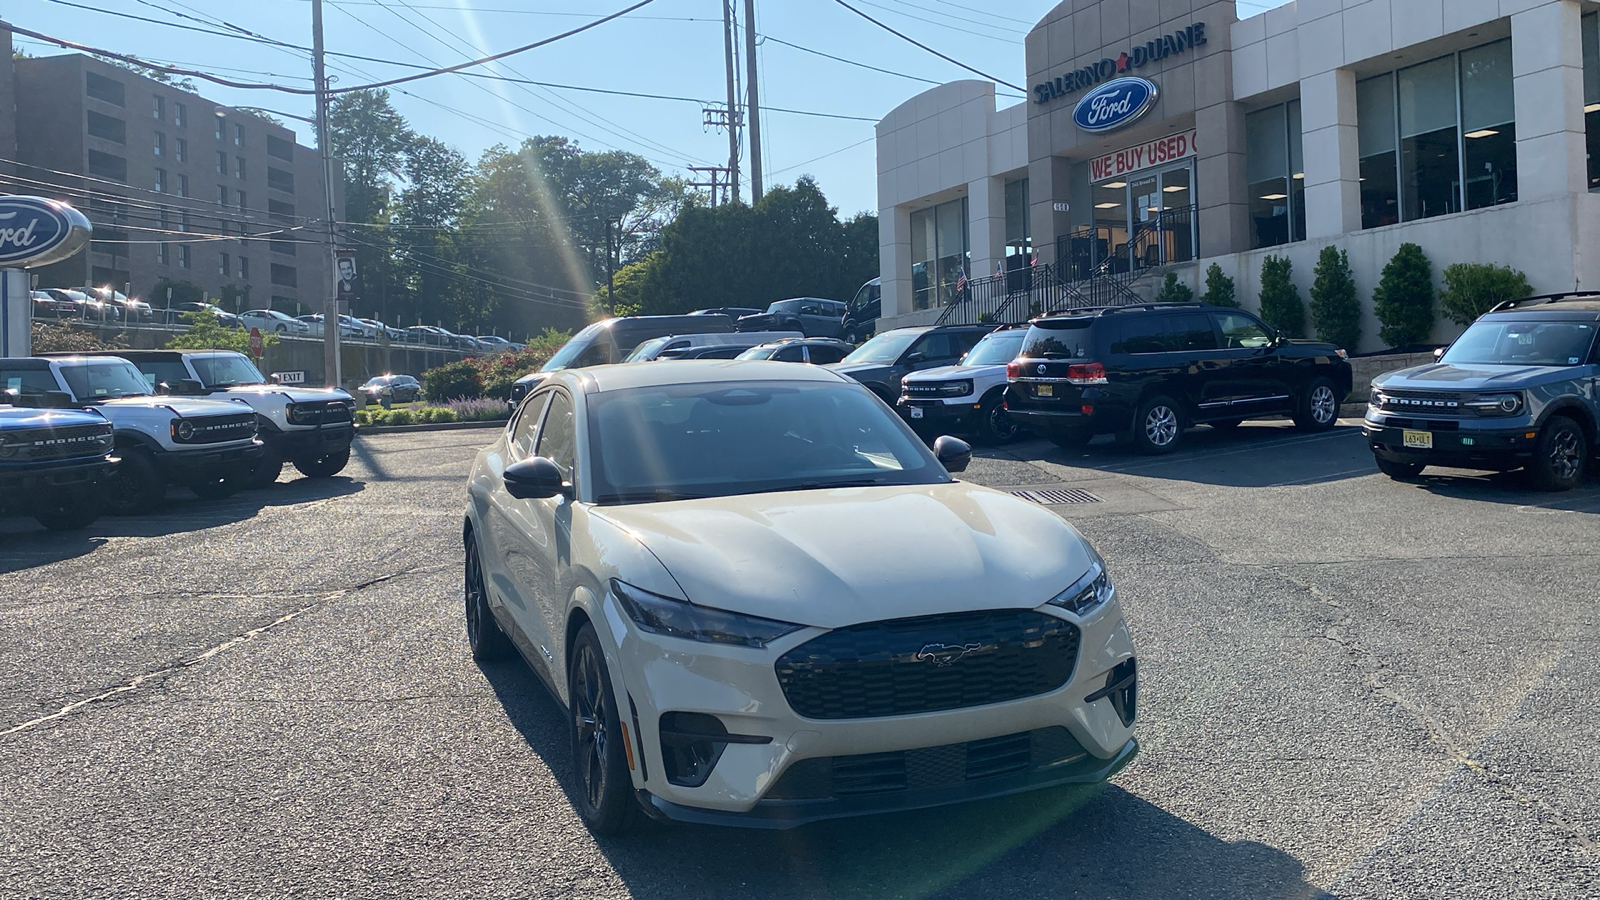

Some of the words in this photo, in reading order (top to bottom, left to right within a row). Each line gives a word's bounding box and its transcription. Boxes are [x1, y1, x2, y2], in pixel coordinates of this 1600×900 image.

[1033, 58, 1117, 104] SALERNO
[1132, 22, 1208, 68] DUANE
[1088, 90, 1132, 124] Ford
[1091, 156, 1113, 180] WE
[1116, 146, 1143, 174] BUY
[1147, 135, 1187, 165] USED
[283, 373, 301, 381] EXIT
[1389, 398, 1458, 407] BRONCO
[206, 422, 248, 431] BRONCO
[34, 436, 95, 446] BRONCO
